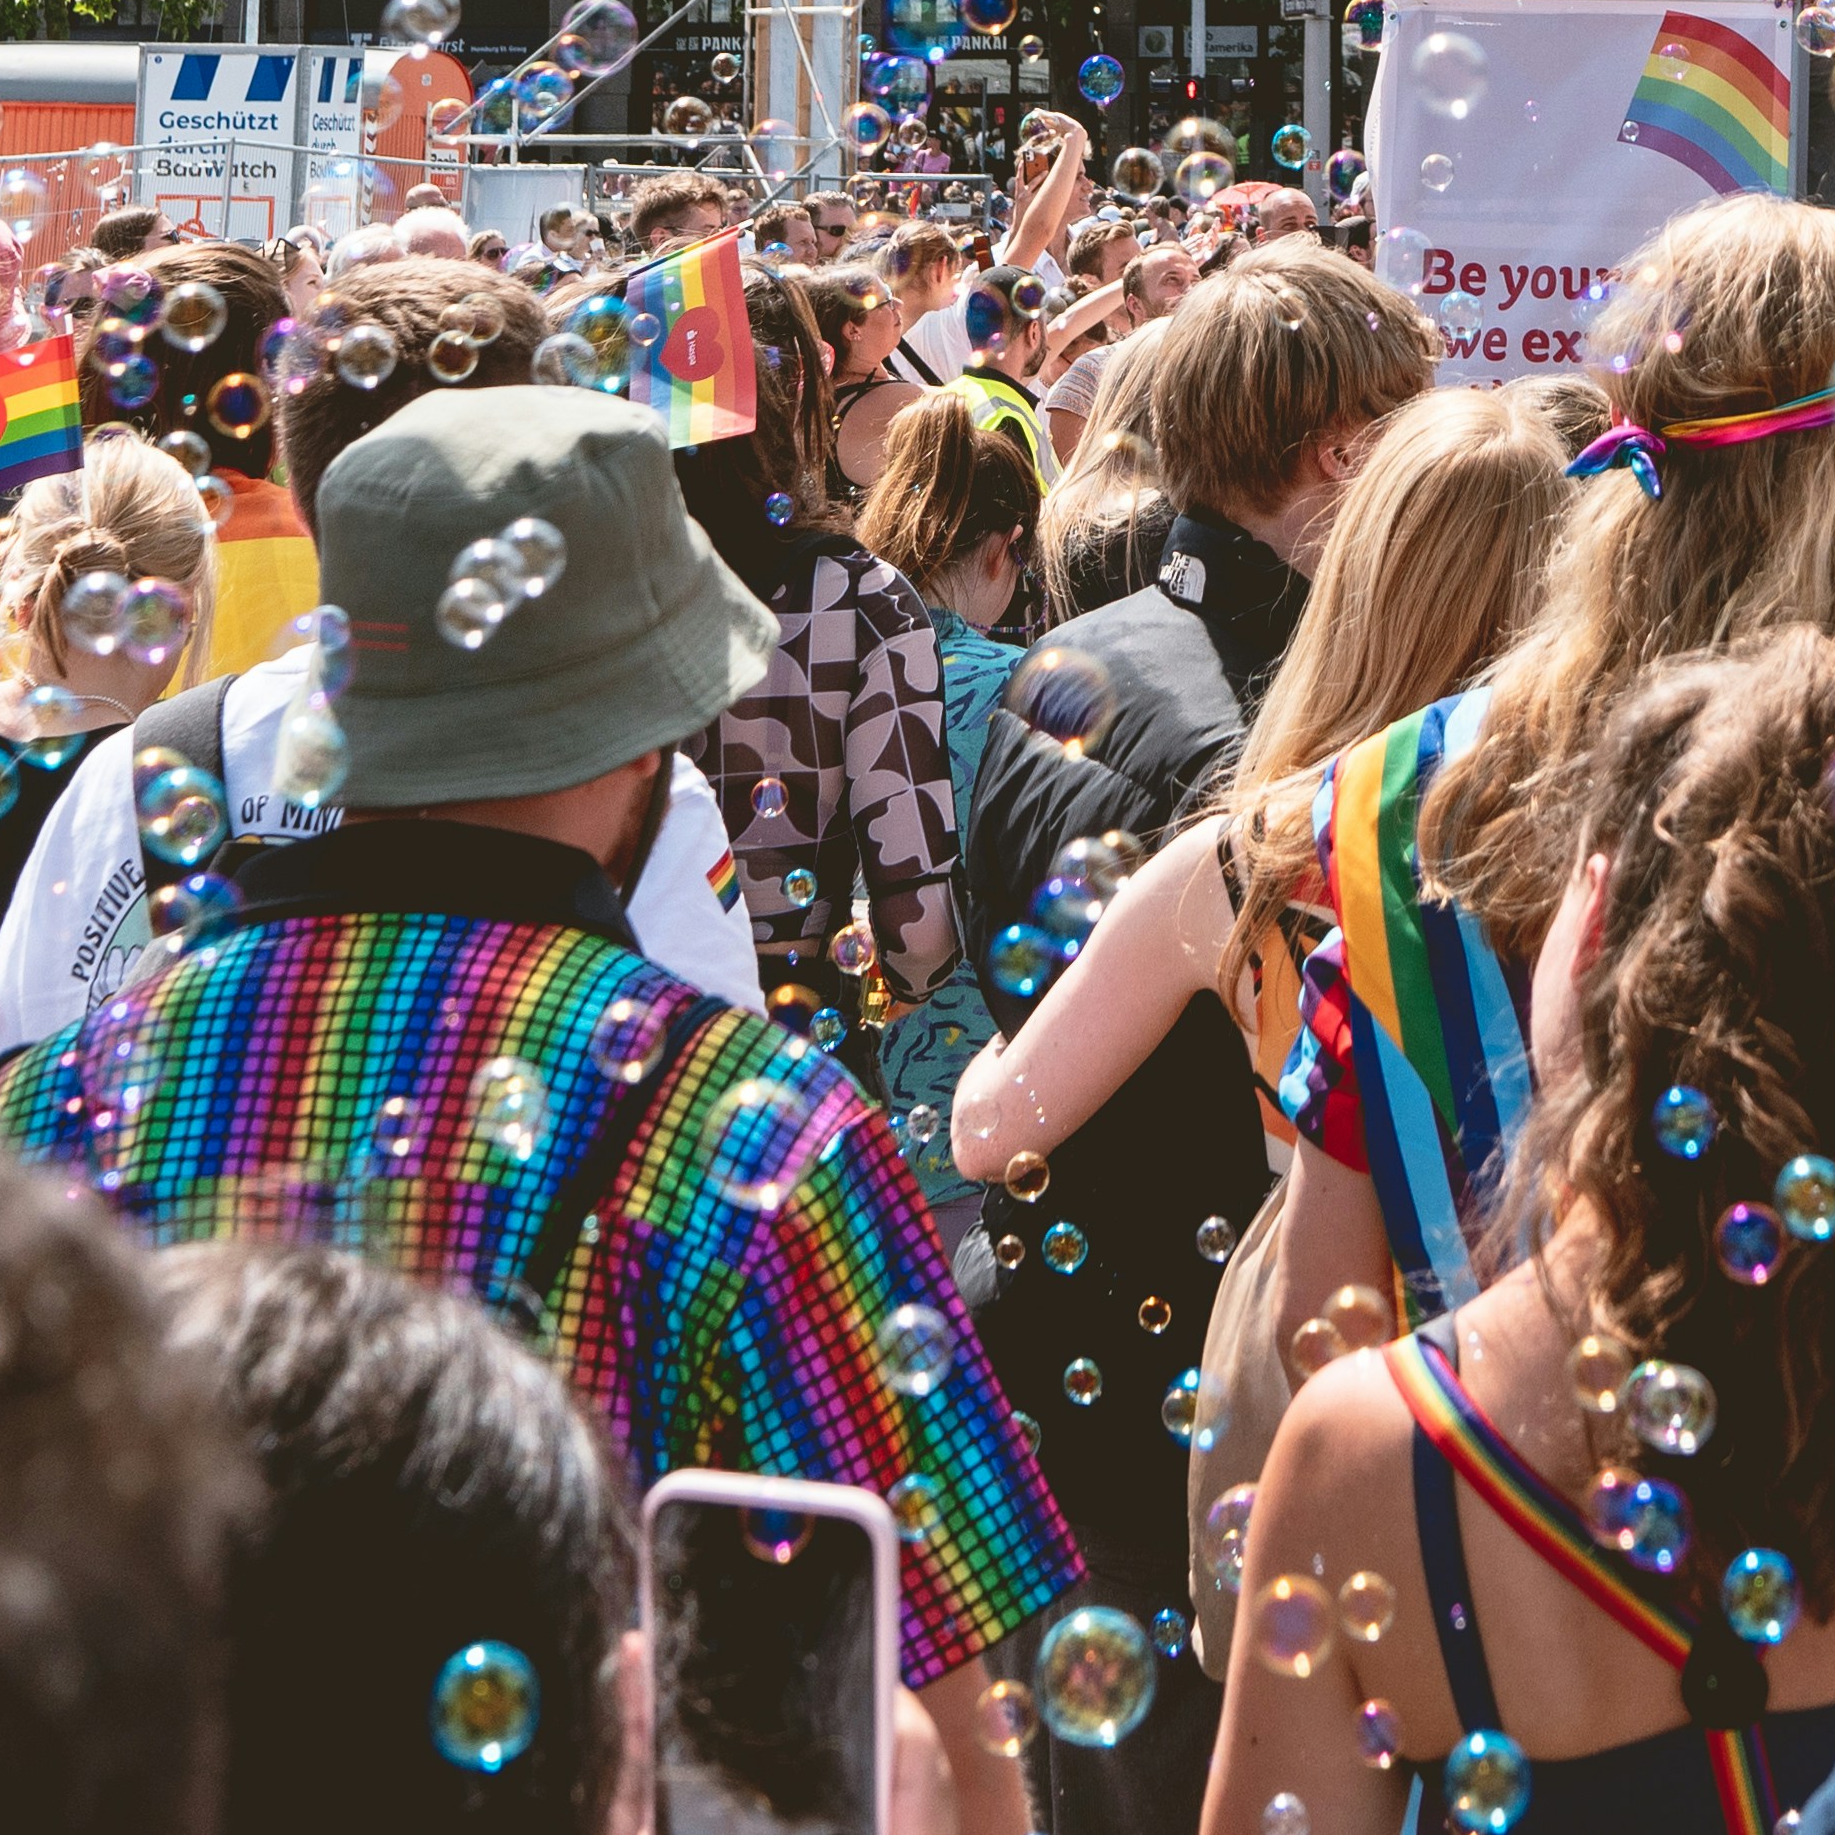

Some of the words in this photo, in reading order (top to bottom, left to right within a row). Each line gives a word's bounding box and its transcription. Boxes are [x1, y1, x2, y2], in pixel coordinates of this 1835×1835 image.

[951, 36, 1007, 50] PANKAI
[1188, 43, 1254, 53] Samerika
[159, 110, 279, 131] Geschützt
[312, 112, 356, 132] Geschützt
[158, 135, 227, 154] durch
[156, 158, 277, 179] BauWatch
[1422, 248, 1487, 296] Be
[1439, 325, 1508, 363] we
[242, 795, 270, 825] OF
[280, 800, 345, 834] MIN
[71, 857, 147, 983] POSITIVE
